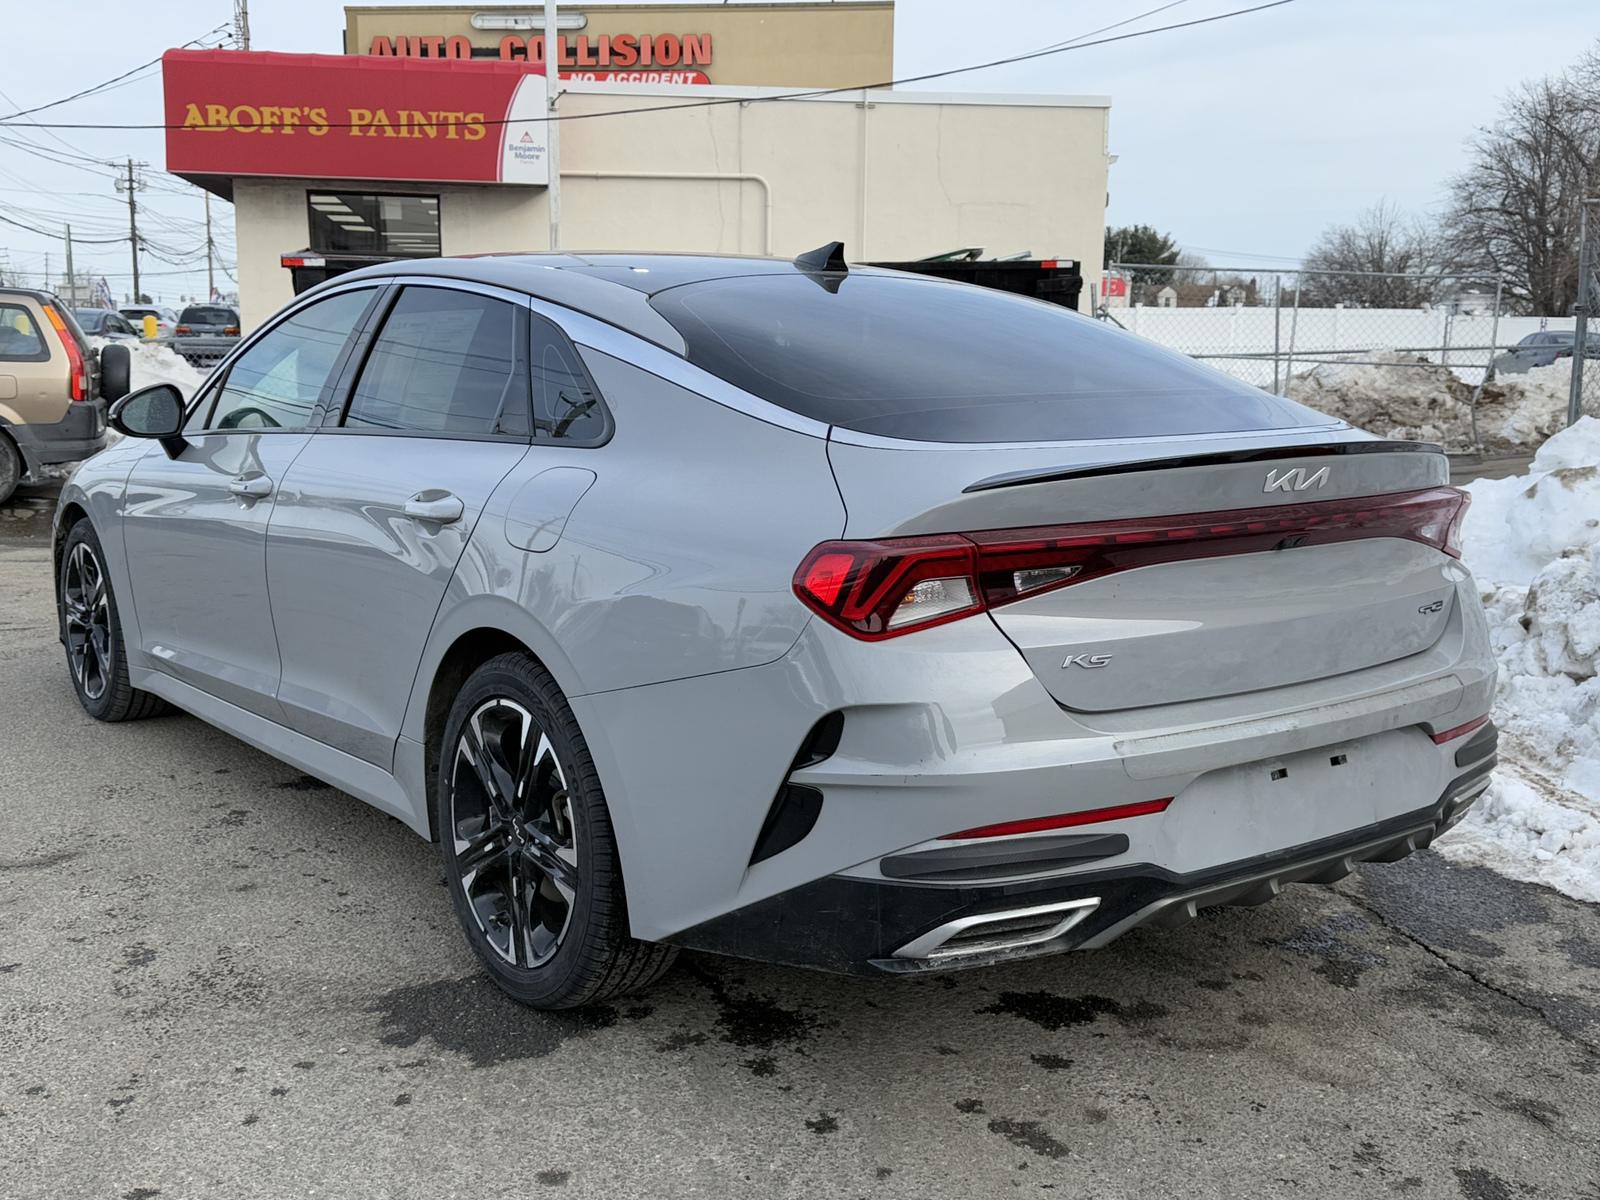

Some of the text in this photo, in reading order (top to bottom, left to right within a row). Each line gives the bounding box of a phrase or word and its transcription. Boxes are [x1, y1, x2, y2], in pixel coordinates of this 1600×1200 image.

[370, 34, 713, 66] AUTO COLLISION
[606, 72, 697, 84] ACCIDENT
[180, 103, 486, 140] ABOFF'S PAINTS
[508, 143, 546, 153] Benjamin
[514, 152, 540, 160] Moore
[1262, 466, 1331, 493] KIA
